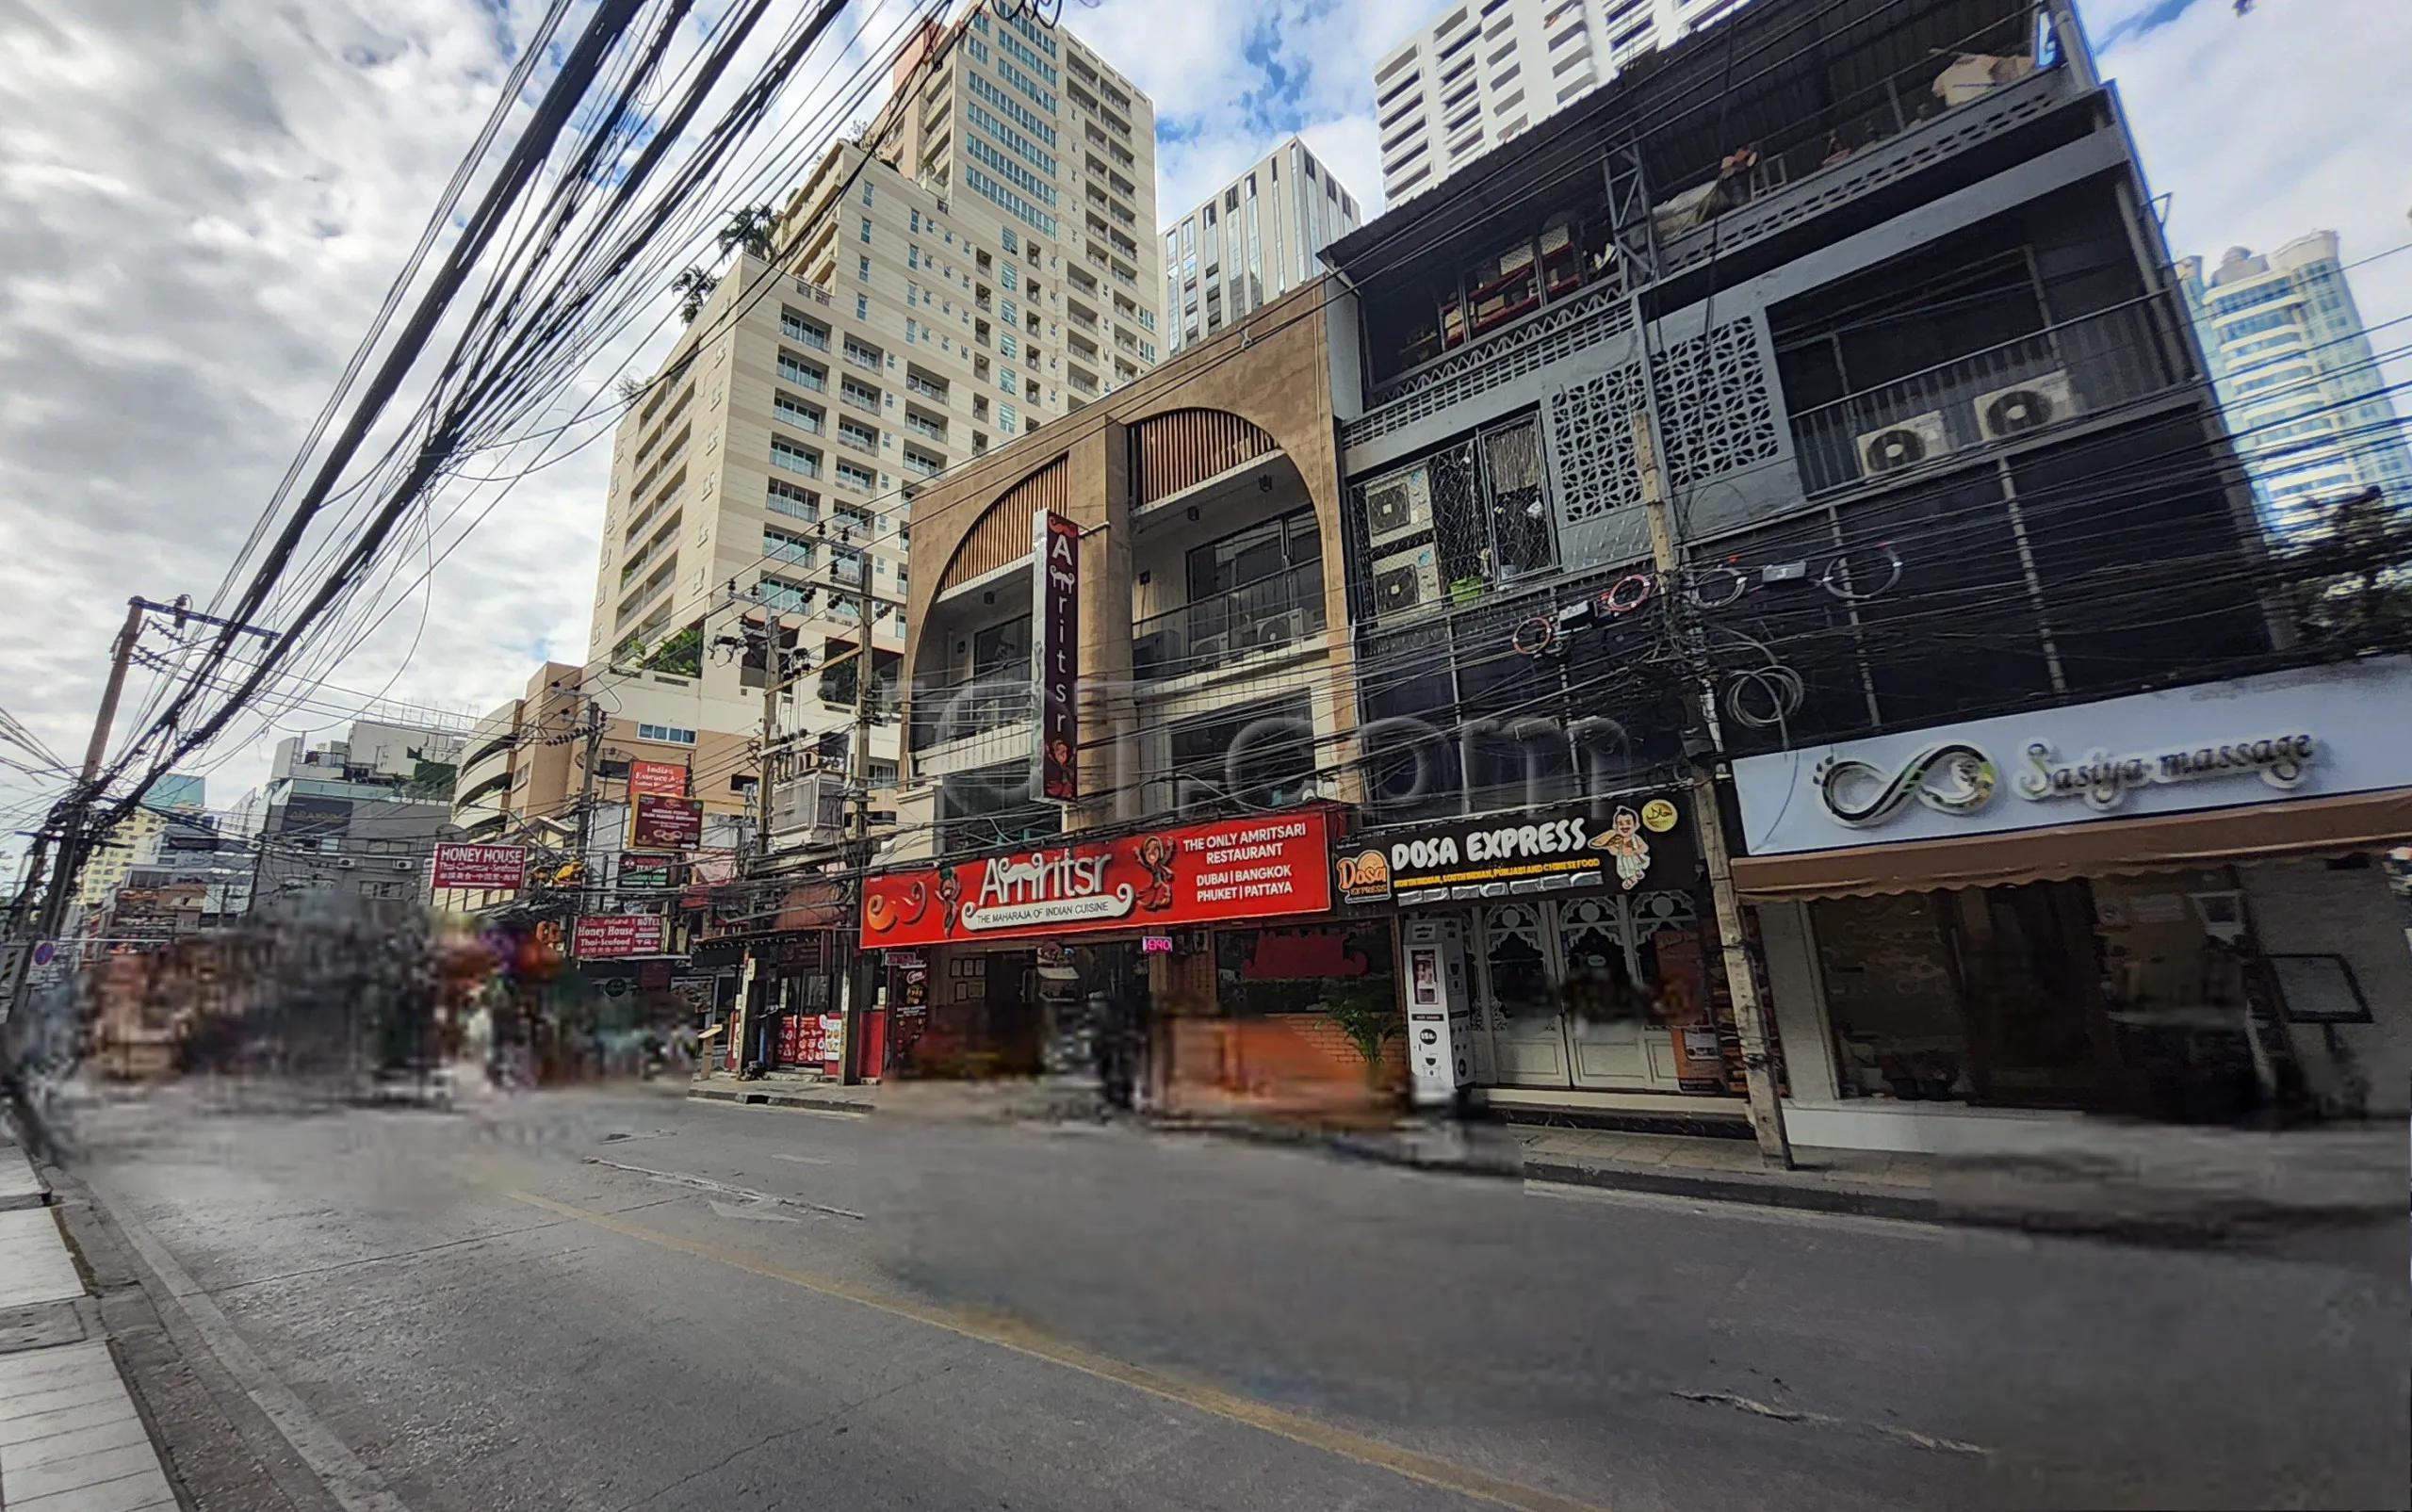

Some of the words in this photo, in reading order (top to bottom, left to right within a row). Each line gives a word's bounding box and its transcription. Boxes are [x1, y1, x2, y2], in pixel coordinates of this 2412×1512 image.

[1051, 534, 1076, 733] Amritsr
[2020, 741, 2149, 805] Sasiya
[2158, 734, 2314, 781] massage
[1182, 838, 1205, 852] THE
[1206, 833, 1237, 849] ONLY
[1239, 822, 1306, 844] AMRITSARI
[1392, 837, 1459, 870] DOSA
[1466, 818, 1587, 862] EXPRESS
[441, 847, 482, 862] HONEY
[483, 849, 522, 864] HOUSE
[1206, 842, 1283, 865] RESTAURANT
[1577, 858, 1600, 868] FOOD
[978, 848, 1112, 906] Amritsr
[1196, 873, 1228, 886] DUBAI
[1235, 865, 1292, 882] BANGKOK
[1338, 859, 1387, 890] Dosa
[1197, 887, 1237, 902] PHUKET
[1244, 881, 1293, 898] PATTAYA
[1350, 885, 1387, 896] EXPRESS
[977, 915, 990, 924] THE
[992, 910, 1032, 922] MAHARAJA
[1034, 907, 1044, 918] OF
[1046, 904, 1073, 918] INDIAN
[1075, 901, 1109, 915] CUISINE
[578, 926, 605, 937] Honey
[608, 926, 634, 935] House
